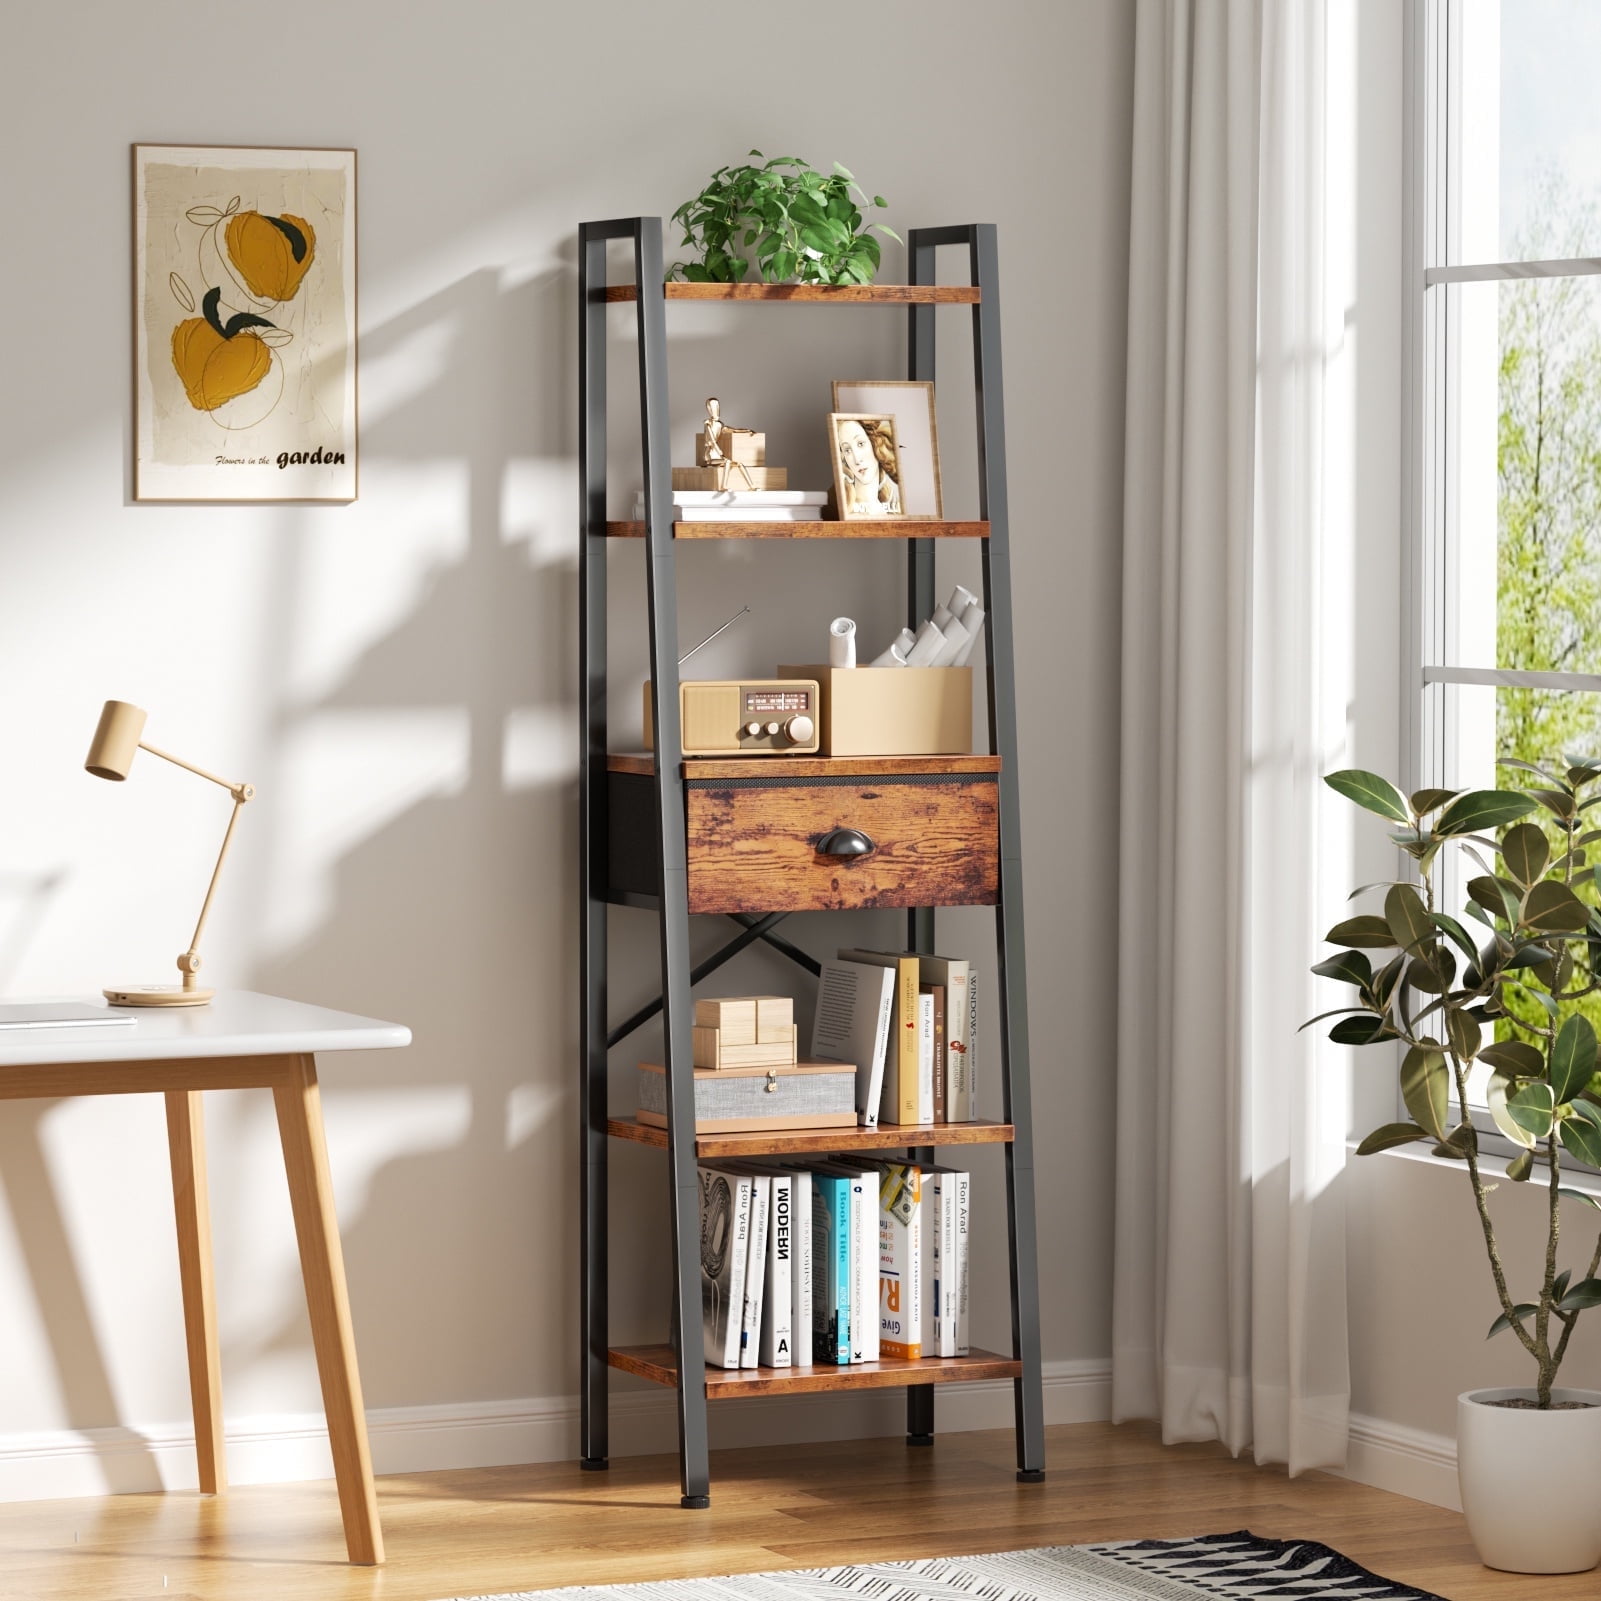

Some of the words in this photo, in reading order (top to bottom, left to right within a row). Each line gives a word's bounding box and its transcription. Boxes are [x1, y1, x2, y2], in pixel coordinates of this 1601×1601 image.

[215, 455, 245, 466] Flowers
[248, 457, 256, 465] in
[258, 456, 270, 465] the
[276, 446, 345, 470] garden
[959, 1181, 967, 1204] Ron
[959, 1208, 967, 1234] Arad
[855, 1235, 862, 1244] OF
[880, 1255, 894, 1265] how
[881, 1319, 901, 1335] Give
[777, 1339, 789, 1353] A
